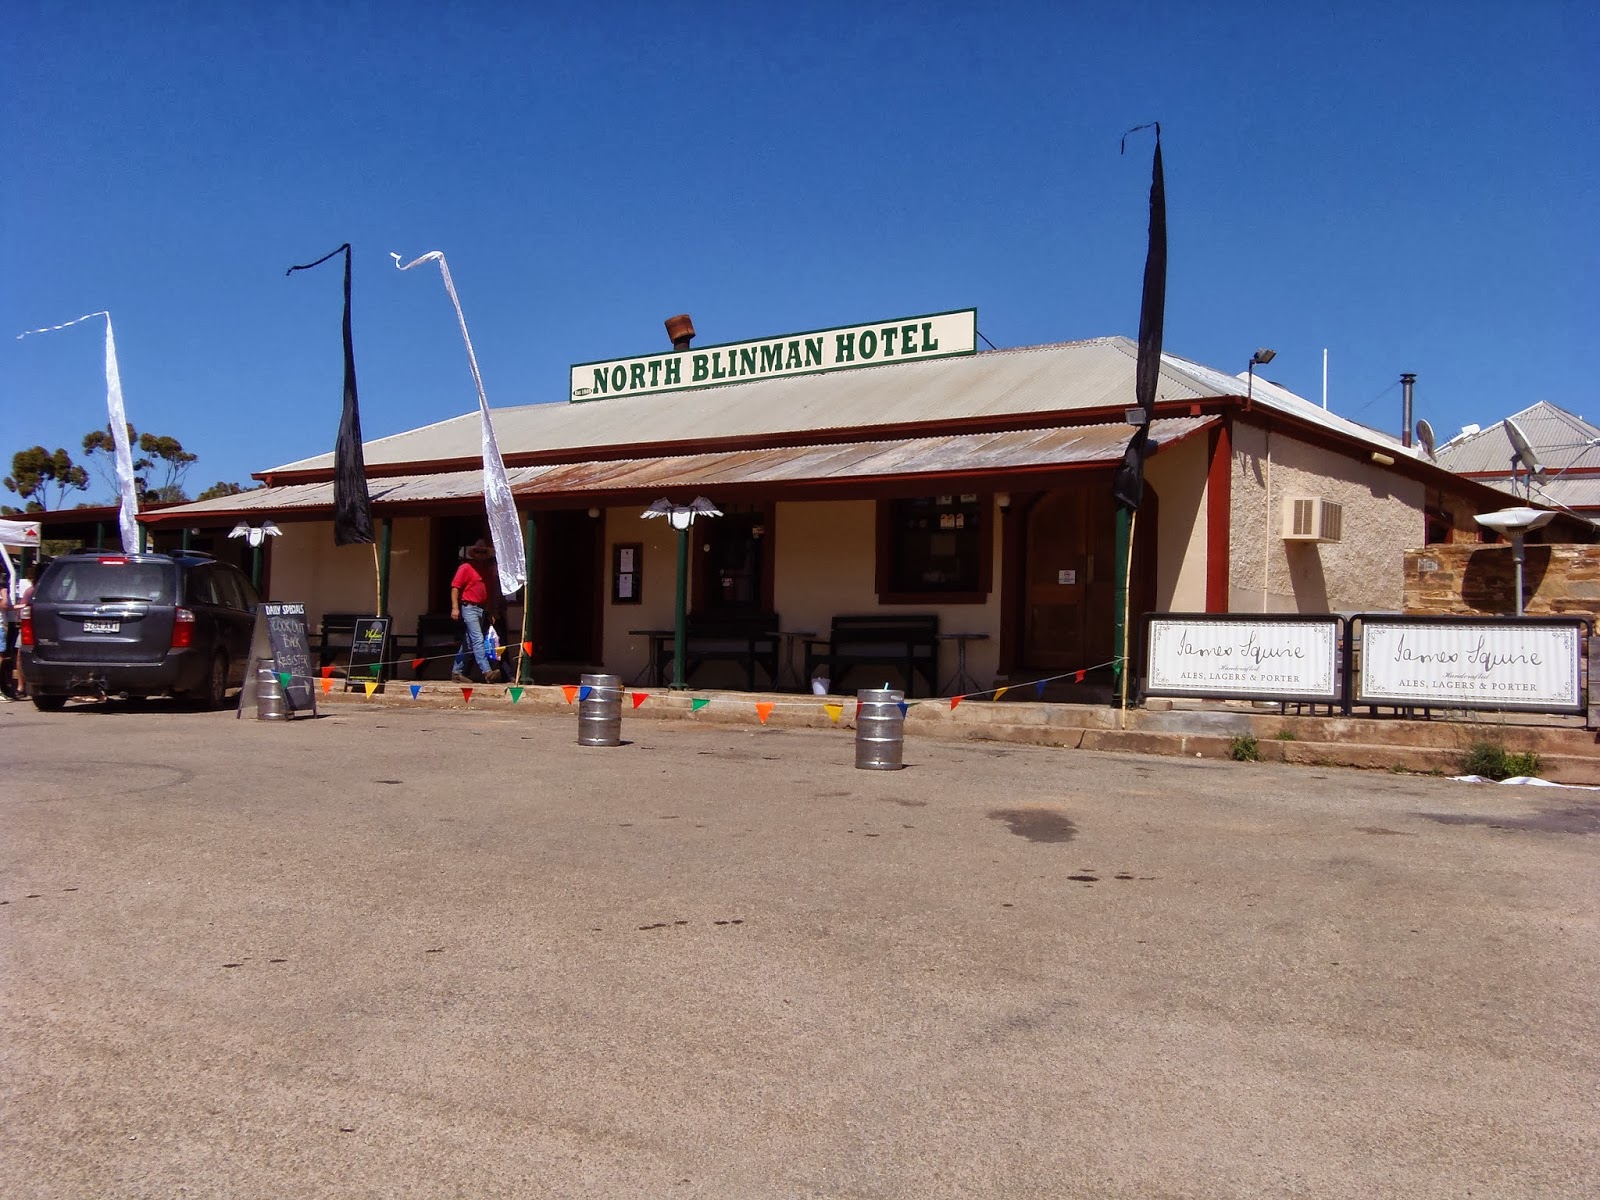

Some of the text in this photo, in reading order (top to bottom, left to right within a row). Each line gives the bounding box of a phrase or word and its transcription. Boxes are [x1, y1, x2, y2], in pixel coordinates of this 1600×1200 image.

[593, 322, 938, 394] NORTH BLINMAN HOTEL
[265, 604, 305, 616] DAILY SPECIALS
[1177, 629, 1304, 664] James Squire
[1394, 633, 1542, 672] James Squire
[1180, 671, 1206, 681] ALES,
[1209, 672, 1246, 681] LAGERS
[1260, 674, 1300, 683] PORTER
[1399, 679, 1538, 692] ALES, LAGERS & PORTER
